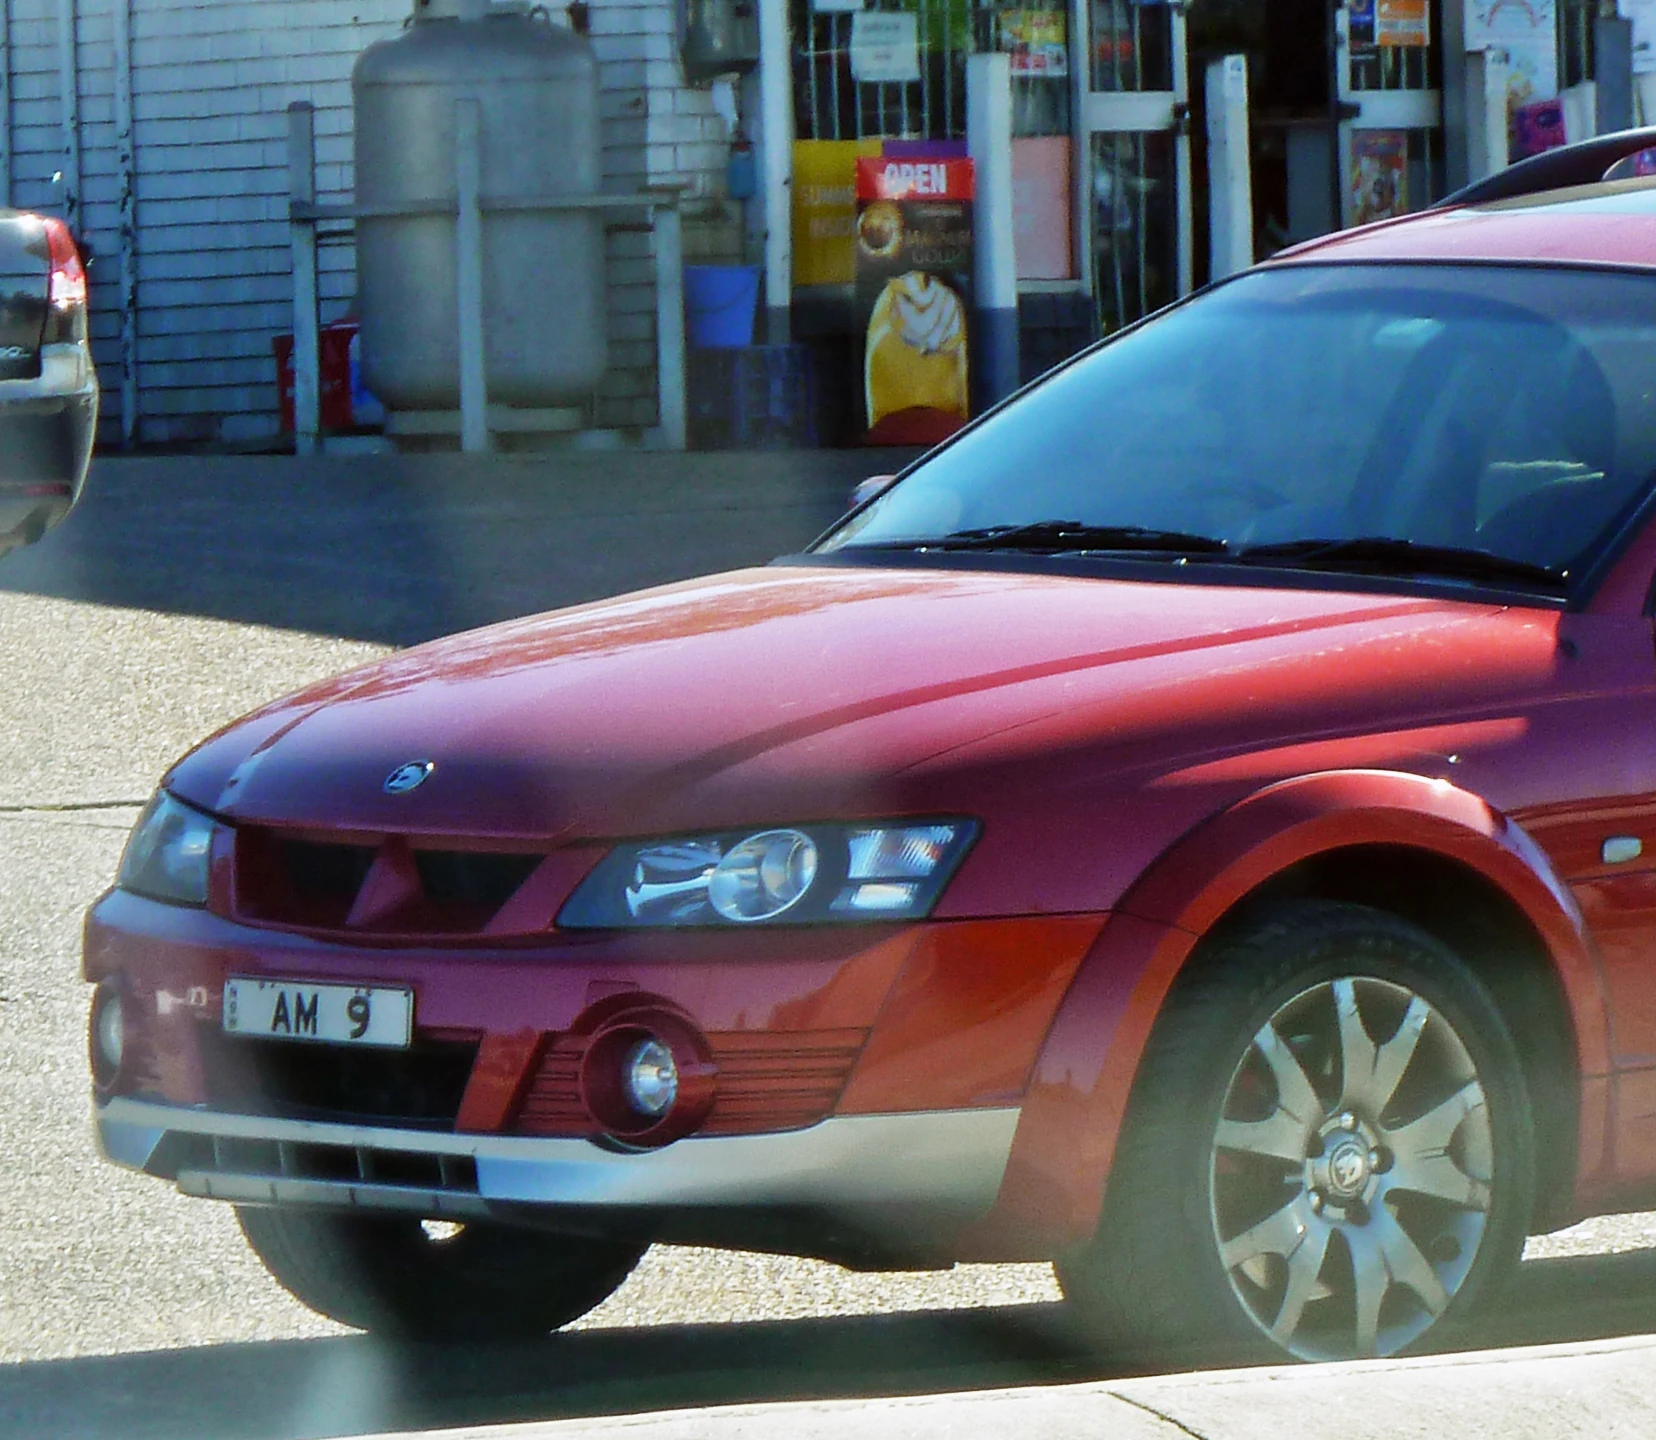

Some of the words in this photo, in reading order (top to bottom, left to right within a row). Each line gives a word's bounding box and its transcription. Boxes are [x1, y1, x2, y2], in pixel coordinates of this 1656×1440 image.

[883, 162, 948, 195] OPEN
[271, 991, 319, 1036] AM
[347, 995, 371, 1040] 9
